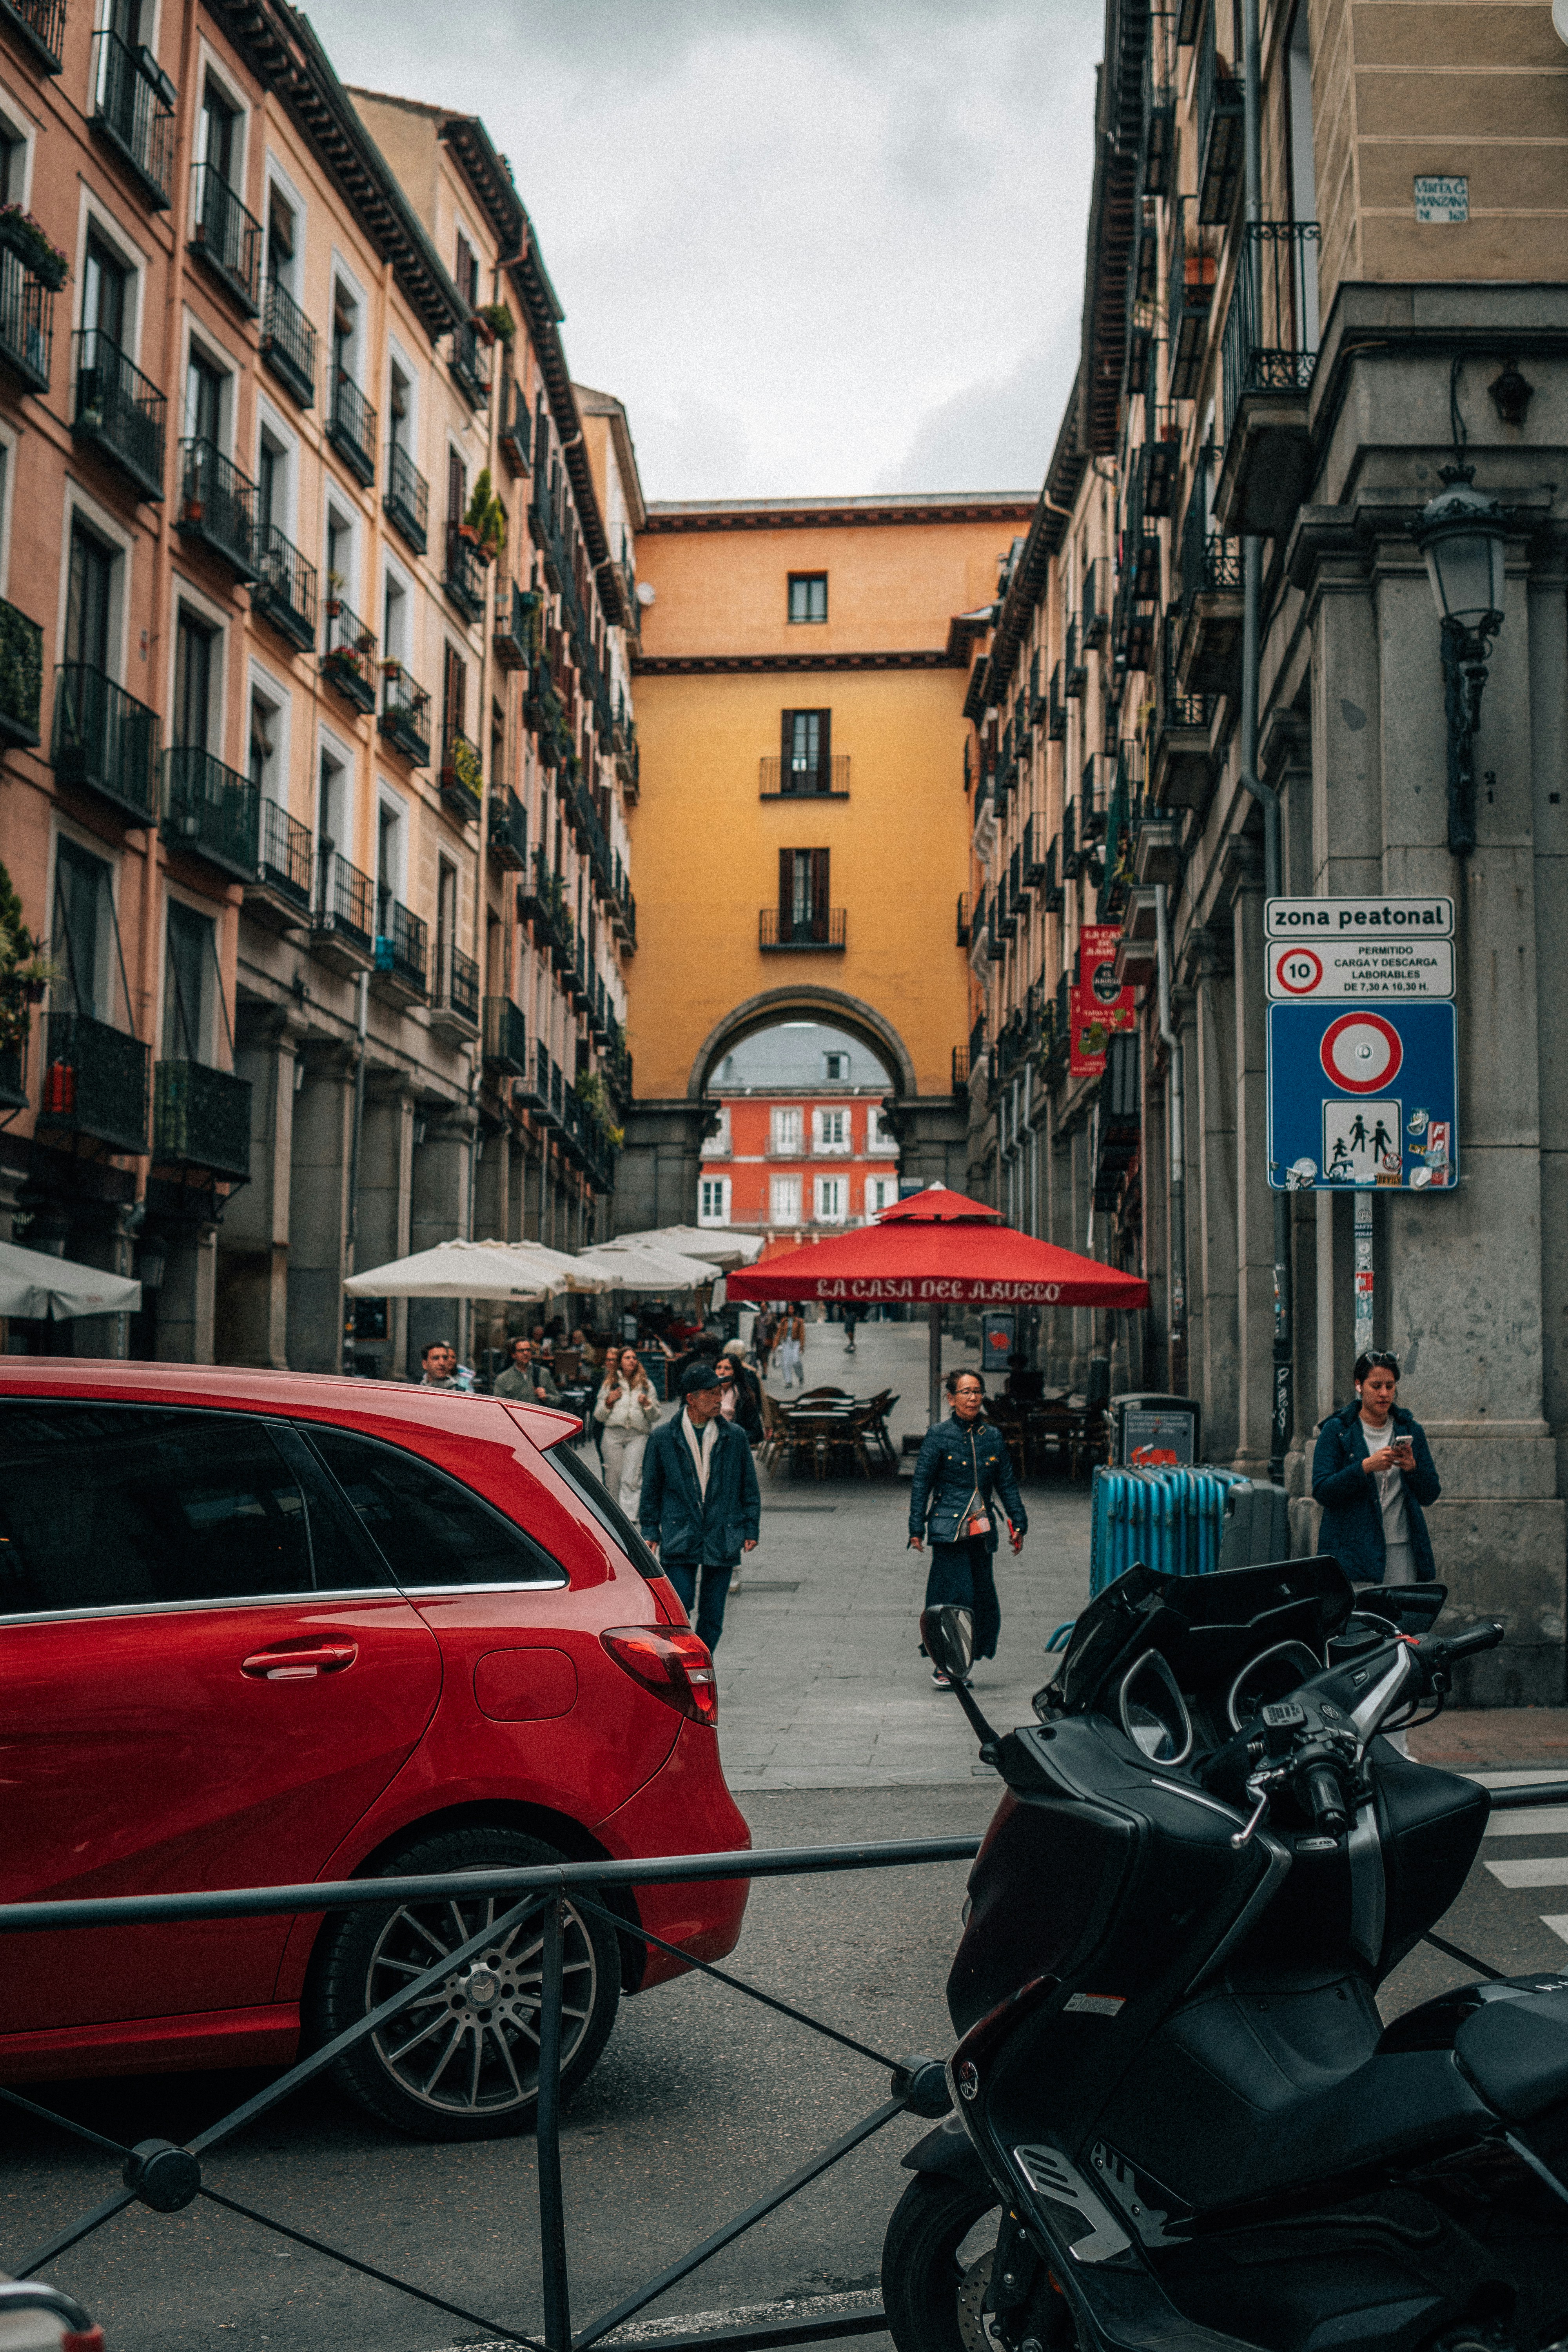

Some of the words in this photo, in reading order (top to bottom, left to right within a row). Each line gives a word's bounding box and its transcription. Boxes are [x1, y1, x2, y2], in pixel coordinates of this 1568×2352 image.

[1416, 196, 1468, 207] MANZANA
[1275, 911, 1330, 926] zona
[1339, 906, 1444, 929] peatonal
[1359, 946, 1414, 955] PERMITIDO
[1334, 958, 1370, 967] CARGA
[1374, 958, 1379, 967] Y
[1381, 957, 1438, 967] DESCARGA
[1290, 964, 1310, 978] 10
[1352, 970, 1421, 979] LABORABLES
[1344, 983, 1357, 991] DE
[1361, 982, 1380, 992] 7,30
[1382, 983, 1389, 991] A
[1393, 982, 1417, 992] 10,30
[817, 1278, 847, 1297] LA
[851, 1279, 914, 1298] CASA
[920, 1280, 963, 1299] DEL
[968, 1281, 1063, 1301] ABUELO
